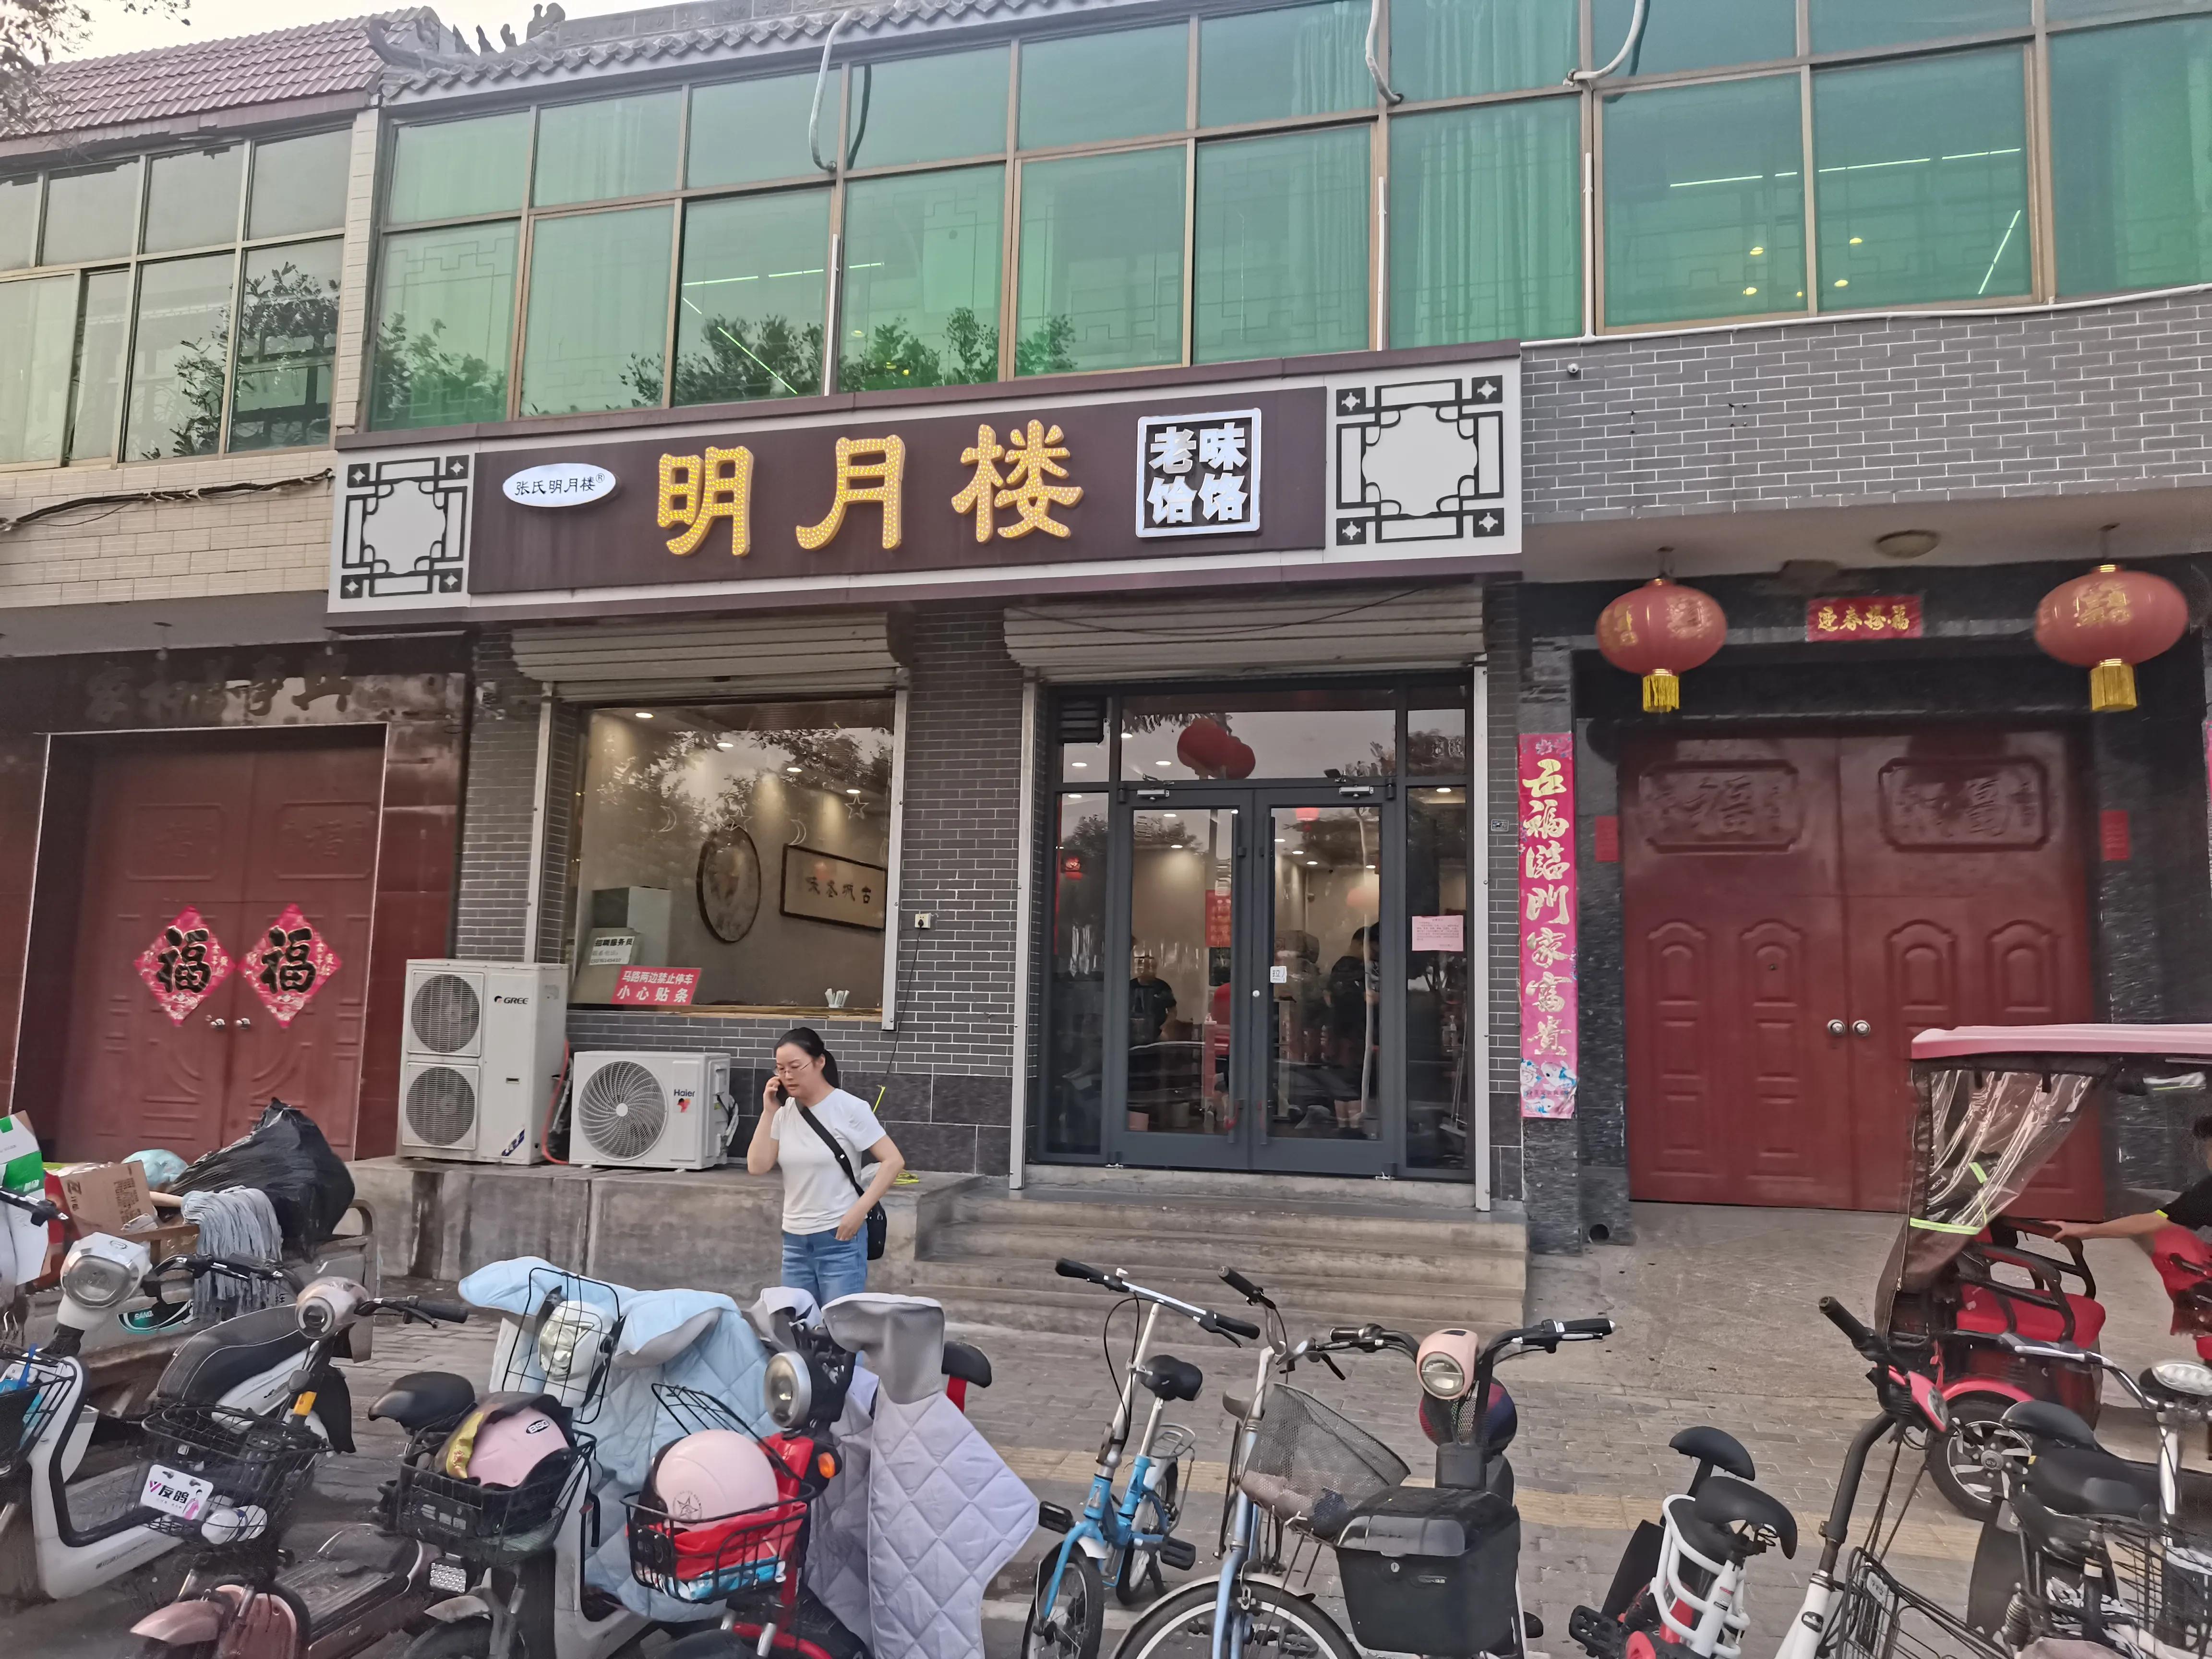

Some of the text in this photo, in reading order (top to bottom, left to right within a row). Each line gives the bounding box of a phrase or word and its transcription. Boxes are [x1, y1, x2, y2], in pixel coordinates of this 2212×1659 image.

[657, 419, 1083, 557] 明月楼
[156, 925, 212, 994] 福
[260, 925, 317, 994] 福
[622, 970, 694, 985] 马路两边禁止停车
[617, 985, 688, 1003] 小心贴条
[673, 1089, 696, 1097] Haier
